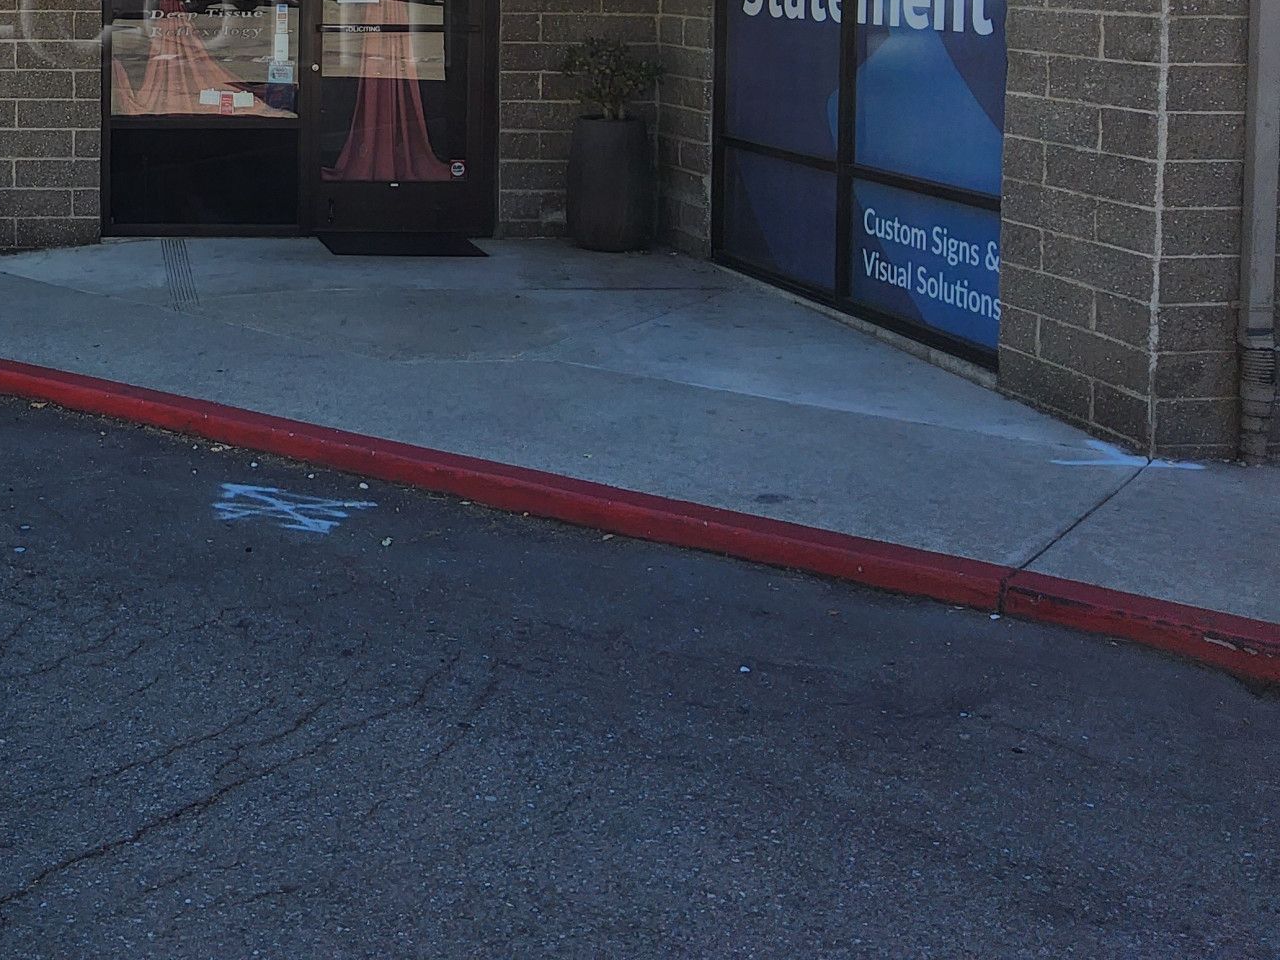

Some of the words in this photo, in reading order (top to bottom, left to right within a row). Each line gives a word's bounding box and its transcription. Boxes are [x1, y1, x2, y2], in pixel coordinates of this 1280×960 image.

[151, 10, 197, 20] Deep
[204, 8, 264, 18] Tissue
[863, 207, 927, 251] Custom
[931, 226, 980, 266] Signs
[985, 240, 1000, 272] &
[862, 248, 912, 290] Visual
[916, 266, 1002, 321] Solutions
